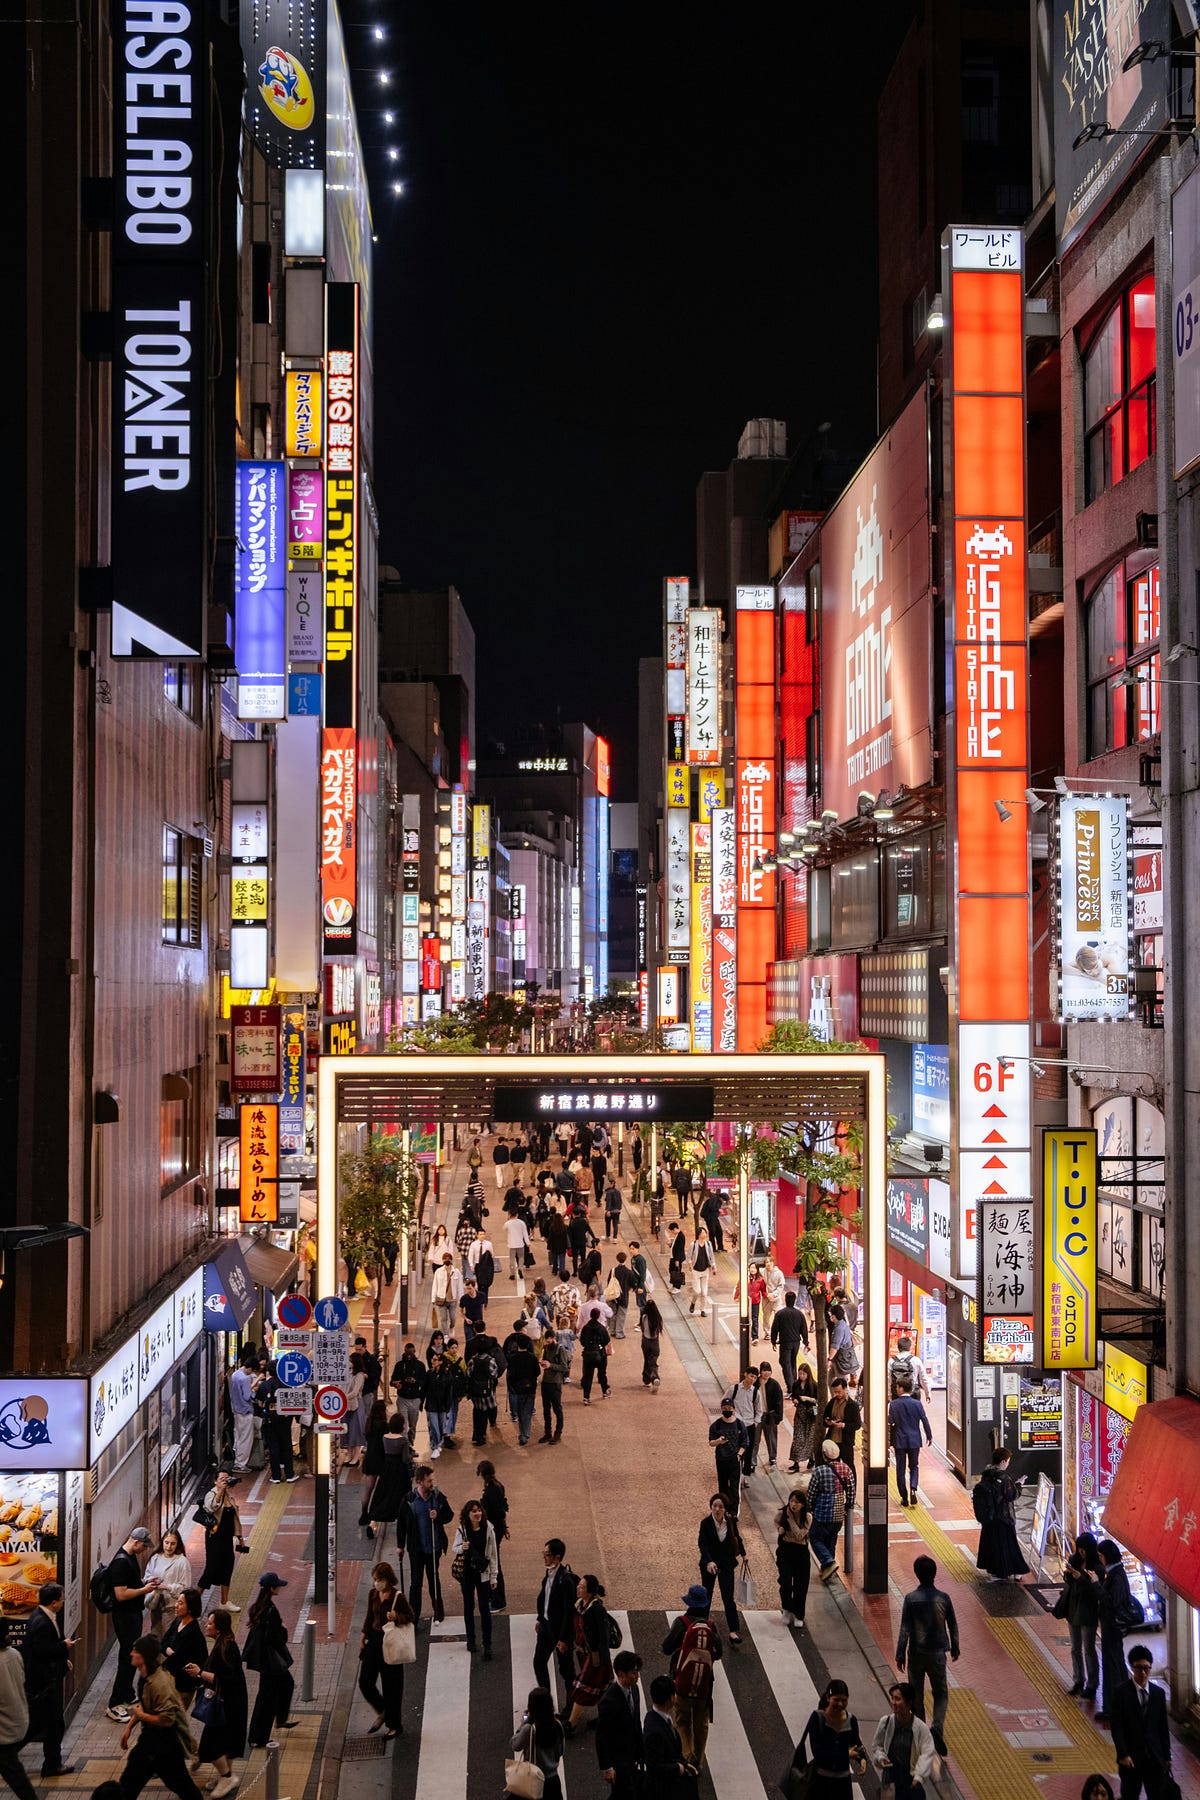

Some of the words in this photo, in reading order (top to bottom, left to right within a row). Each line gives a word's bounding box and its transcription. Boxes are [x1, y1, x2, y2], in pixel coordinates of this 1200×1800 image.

[955, 233, 1012, 248] ワールド
[988, 252, 1017, 268] ビル
[1176, 292, 1199, 357] 03-
[124, 300, 192, 492] TOWER
[295, 374, 316, 455] タウンハウジング
[327, 350, 353, 471] 驚安の殿堂
[248, 468, 268, 593] アパマンショップ
[291, 500, 317, 539] 占い
[292, 545, 314, 557] 5階
[737, 589, 770, 597] ワールド
[755, 600, 773, 609] ビル
[967, 563, 977, 640] TAITO
[694, 625, 711, 726] 和牛と牛タン
[845, 605, 893, 746] GAME
[979, 563, 1015, 758] GAME
[967, 650, 978, 758] STATION
[697, 751, 710, 761] 5F
[847, 748, 865, 787] TAITO
[866, 729, 893, 775] STATION
[322, 749, 344, 865] ベガスベガス
[238, 823, 251, 846] 味王
[1110, 814, 1122, 882] リフレッシュ
[242, 856, 258, 864] 3F
[1077, 824, 1095, 923] Princess
[674, 897, 685, 930] 大江戸
[1091, 878, 1100, 921] プリンセス
[1110, 889, 1122, 929] 新宿店
[1107, 975, 1127, 994] 3F
[236, 1028, 275, 1038] 台湾料理
[973, 1062, 1016, 1092] 6F
[539, 1094, 657, 1110] 新宿武蔵野通り
[249, 1109, 270, 1219] 俺流塩らーめん
[988, 1208, 1034, 1236] 麺屋
[986, 1274, 995, 1306] らーめん
[995, 1239, 1025, 1309] 海神
[987, 1331, 1034, 1346] Highball
[991, 1319, 1022, 1332] Pizza
[1050, 1283, 1062, 1361] 新宿駅東南口店
[1065, 1295, 1076, 1347] SHOP
[285, 1361, 298, 1383] P
[294, 1372, 304, 1383] 40
[322, 1395, 341, 1411] 30
